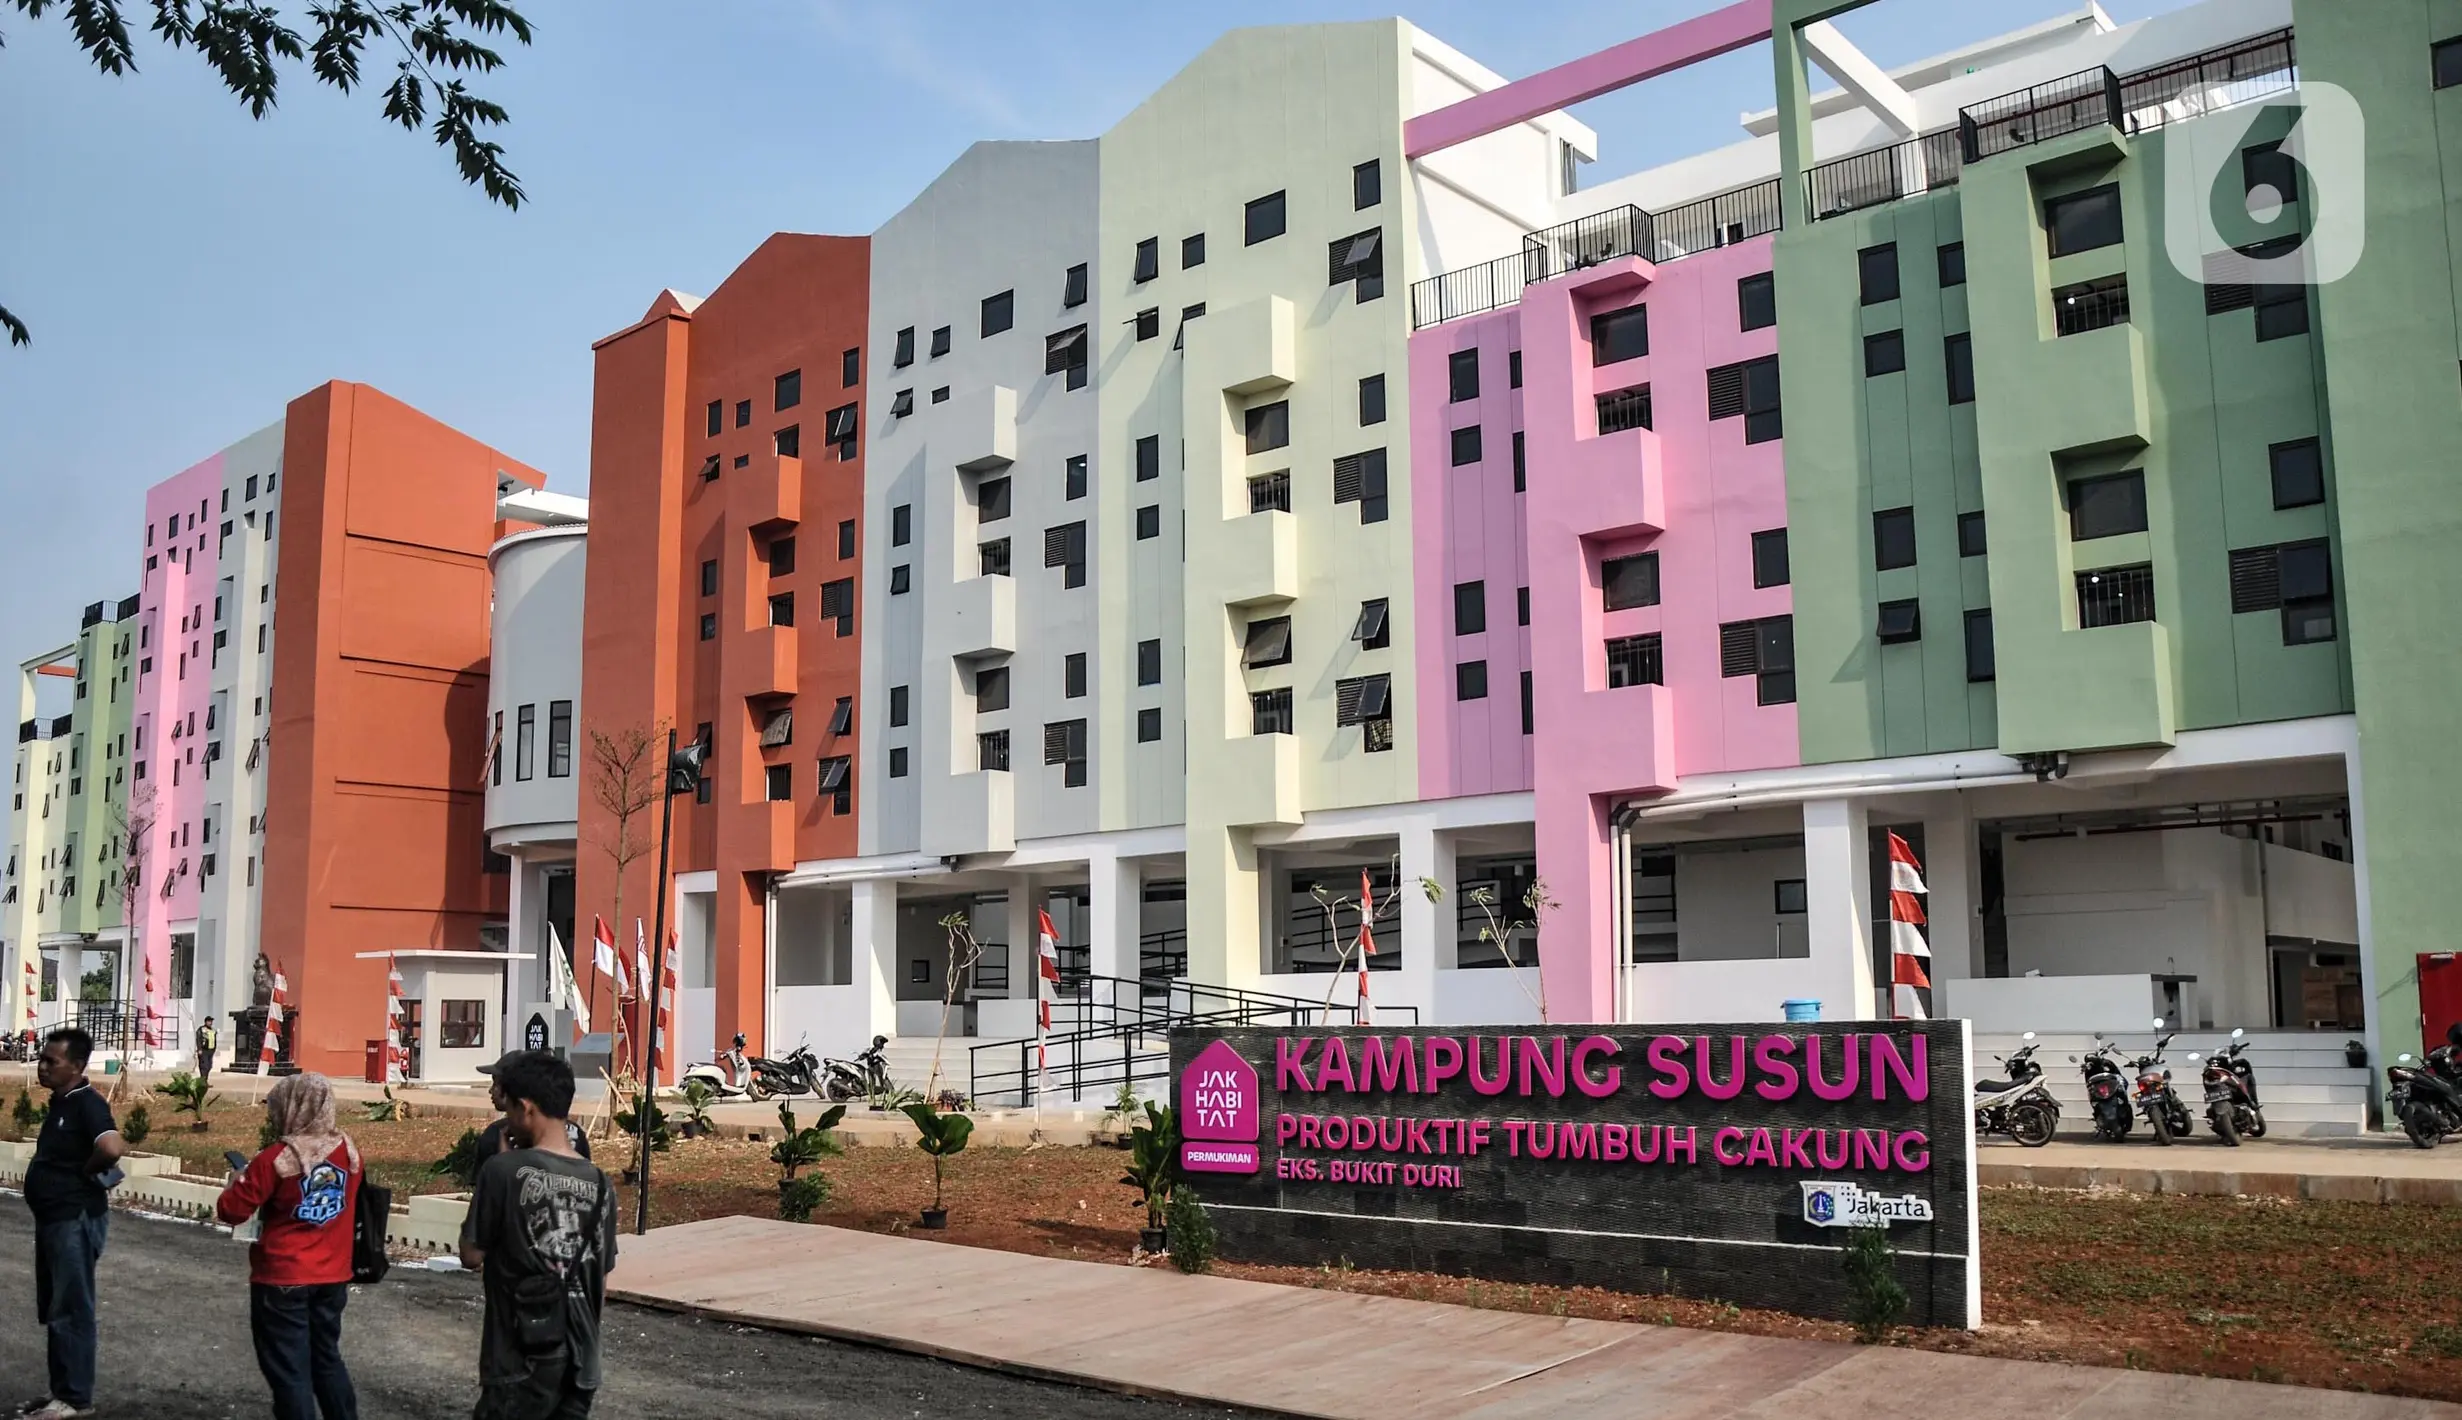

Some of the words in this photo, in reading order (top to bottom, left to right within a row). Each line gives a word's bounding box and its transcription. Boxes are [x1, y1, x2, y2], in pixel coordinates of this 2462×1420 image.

[1276, 1035, 1622, 1098] KAMPUNG
[1647, 1034, 1929, 1102] SUSUN
[1198, 1070, 1238, 1089] JAK
[1195, 1090, 1242, 1109] HABI
[1196, 1109, 1238, 1128] TAT
[1276, 1114, 1491, 1155] PRODUKTIF
[1502, 1121, 1697, 1164] TUMBUH
[1712, 1126, 1930, 1172] CAKUNG
[1187, 1151, 1251, 1164] PERMUKIMAN
[1276, 1158, 1324, 1180] EKS.
[1330, 1160, 1397, 1184] BUKIT
[1402, 1163, 1461, 1188] DURI
[1848, 1196, 1926, 1217] Jakarta
